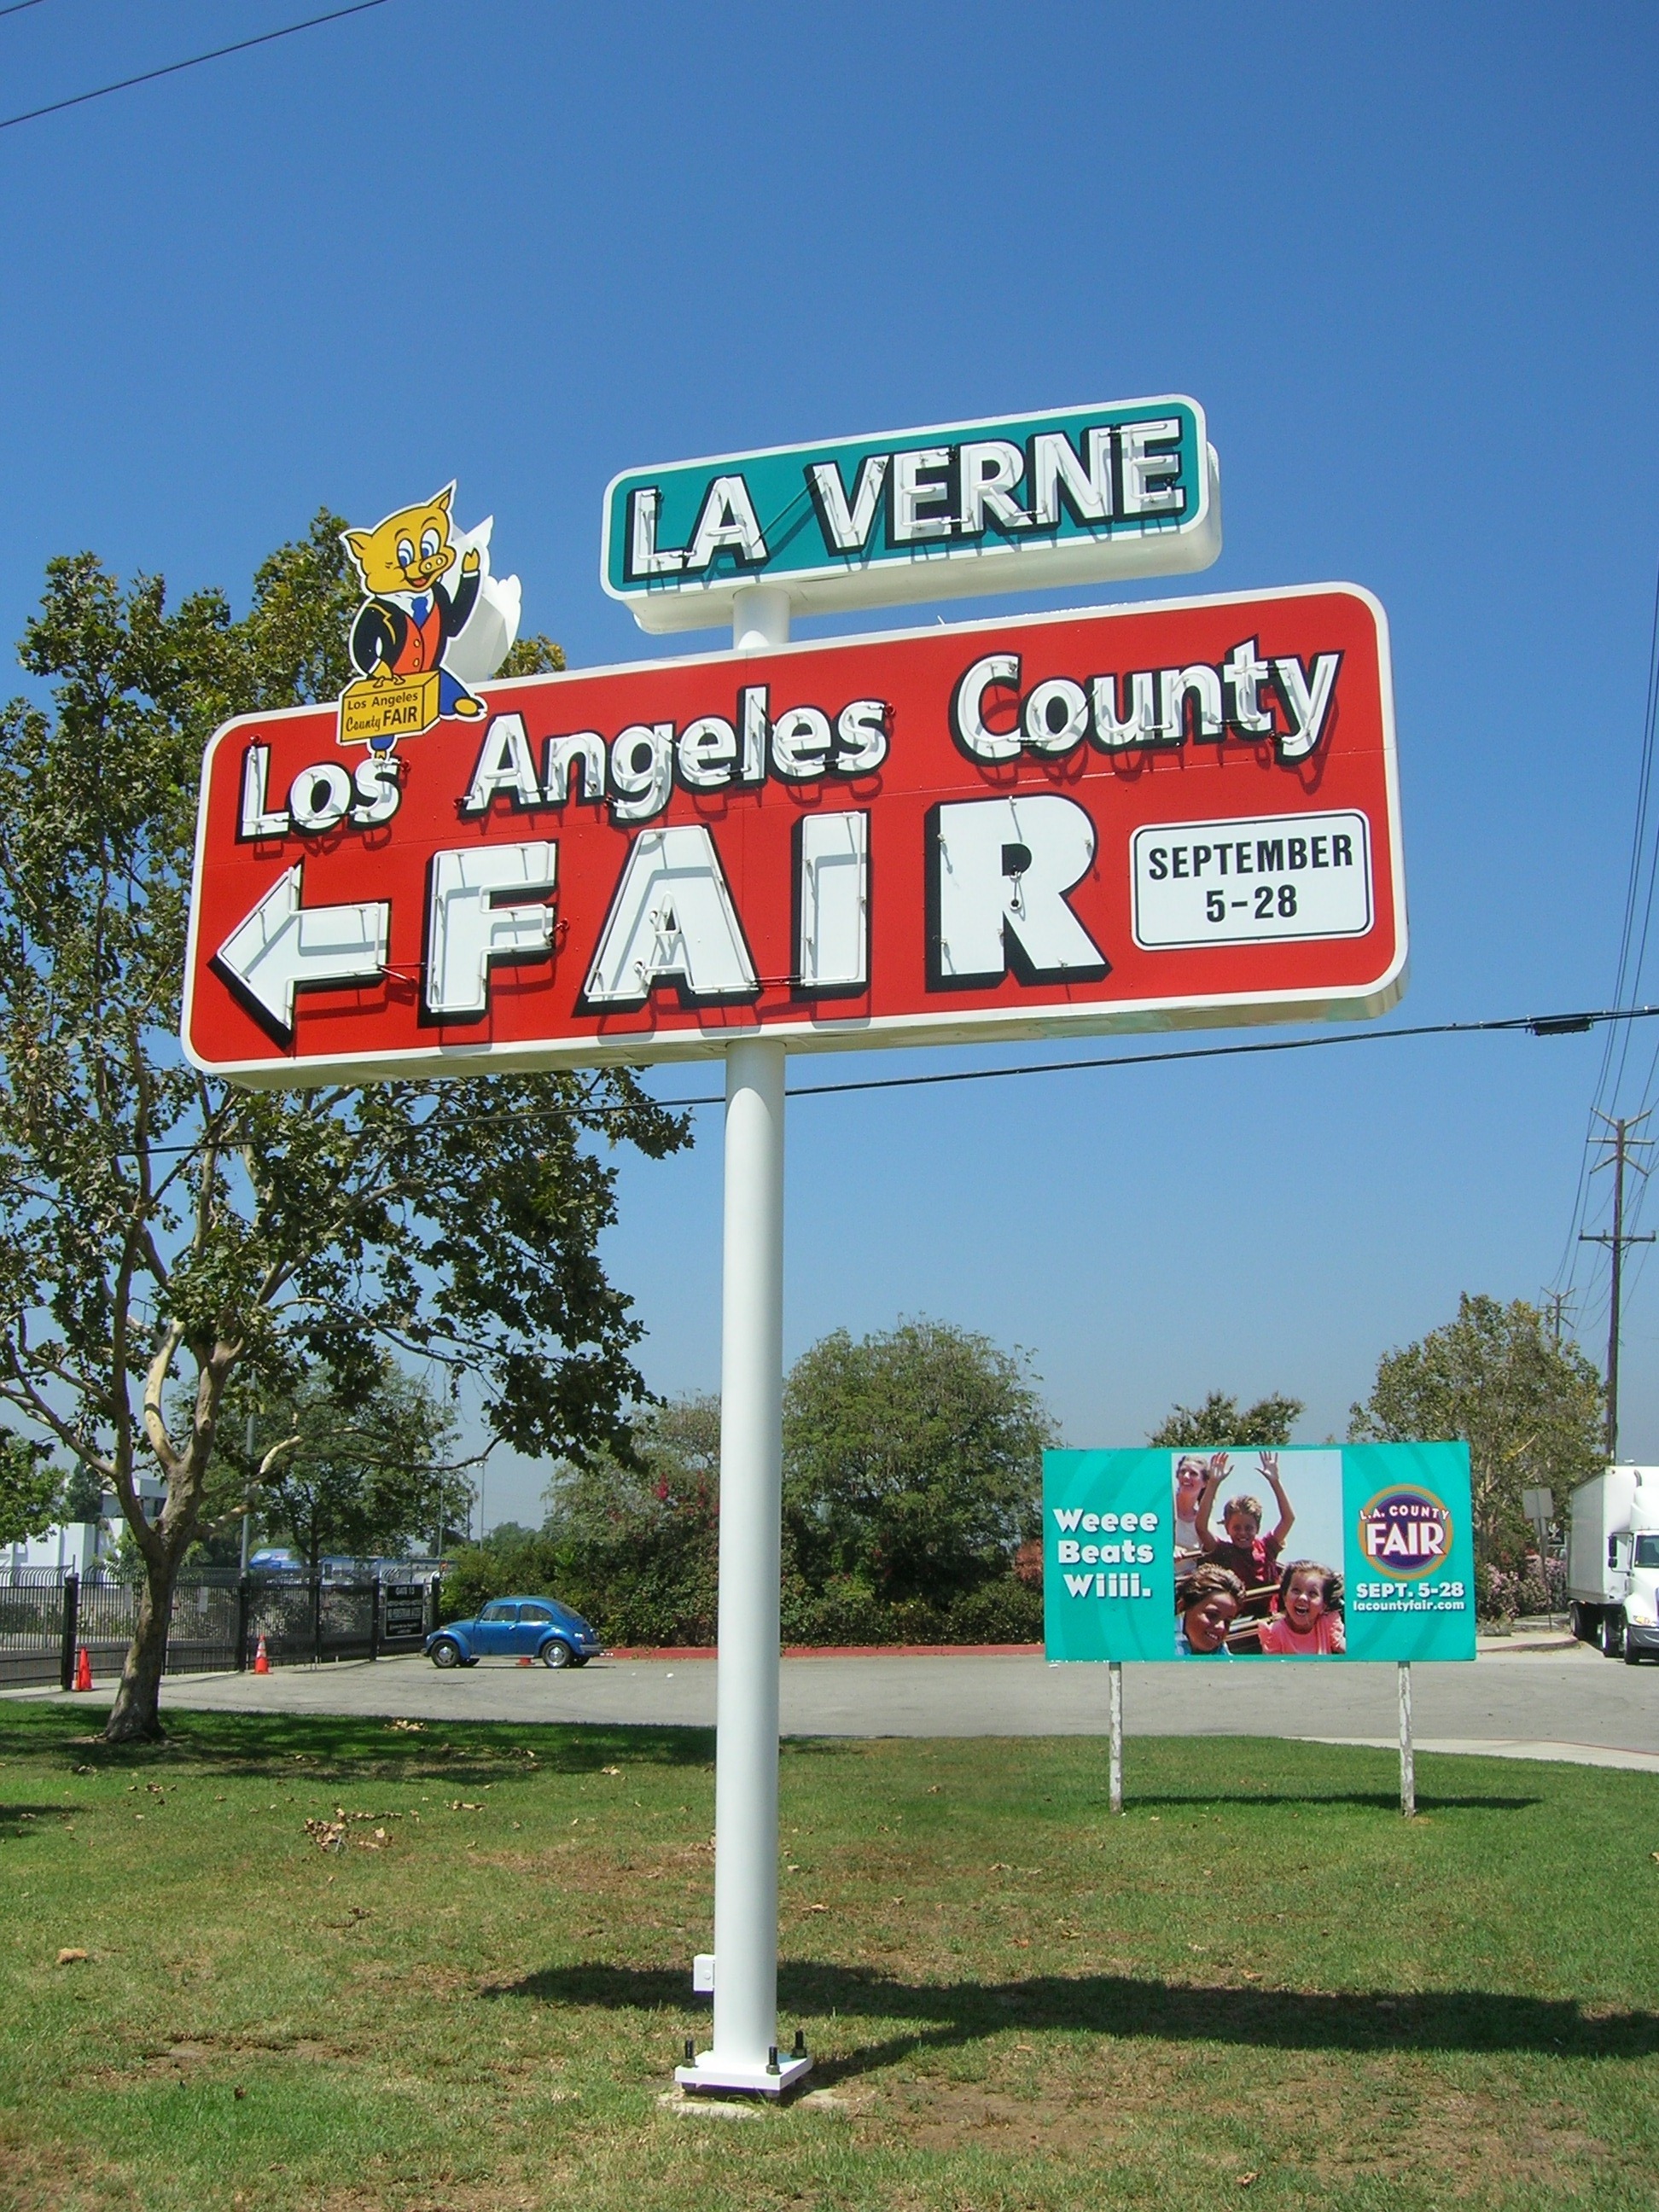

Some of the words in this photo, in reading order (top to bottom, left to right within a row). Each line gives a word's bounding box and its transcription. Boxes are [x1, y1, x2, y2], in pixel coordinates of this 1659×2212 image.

[629, 474, 768, 579] LA
[806, 417, 1186, 553] VERNE
[347, 700, 366, 711] Los
[371, 691, 418, 707] Angeles
[346, 715, 381, 732] County
[382, 705, 417, 727] FAIR
[238, 744, 404, 841] Los
[463, 685, 889, 824] Angeles
[952, 636, 1346, 762] County
[1149, 834, 1353, 881] SEPTEMBER
[423, 794, 1109, 1019] FAIR
[1206, 884, 1297, 923] 5-28
[1052, 1508, 1158, 1533] Weeee
[1359, 1508, 1385, 1520] L.A.
[1388, 1505, 1450, 1520] COUNTY
[1057, 1540, 1154, 1564] Beats
[1366, 1522, 1446, 1556] FAIR
[1062, 1573, 1151, 1598] Wiiii.
[1355, 1583, 1414, 1598] SEPT.
[1417, 1581, 1464, 1598] 5-28
[1353, 1599, 1465, 1611] lacountyfair.com
